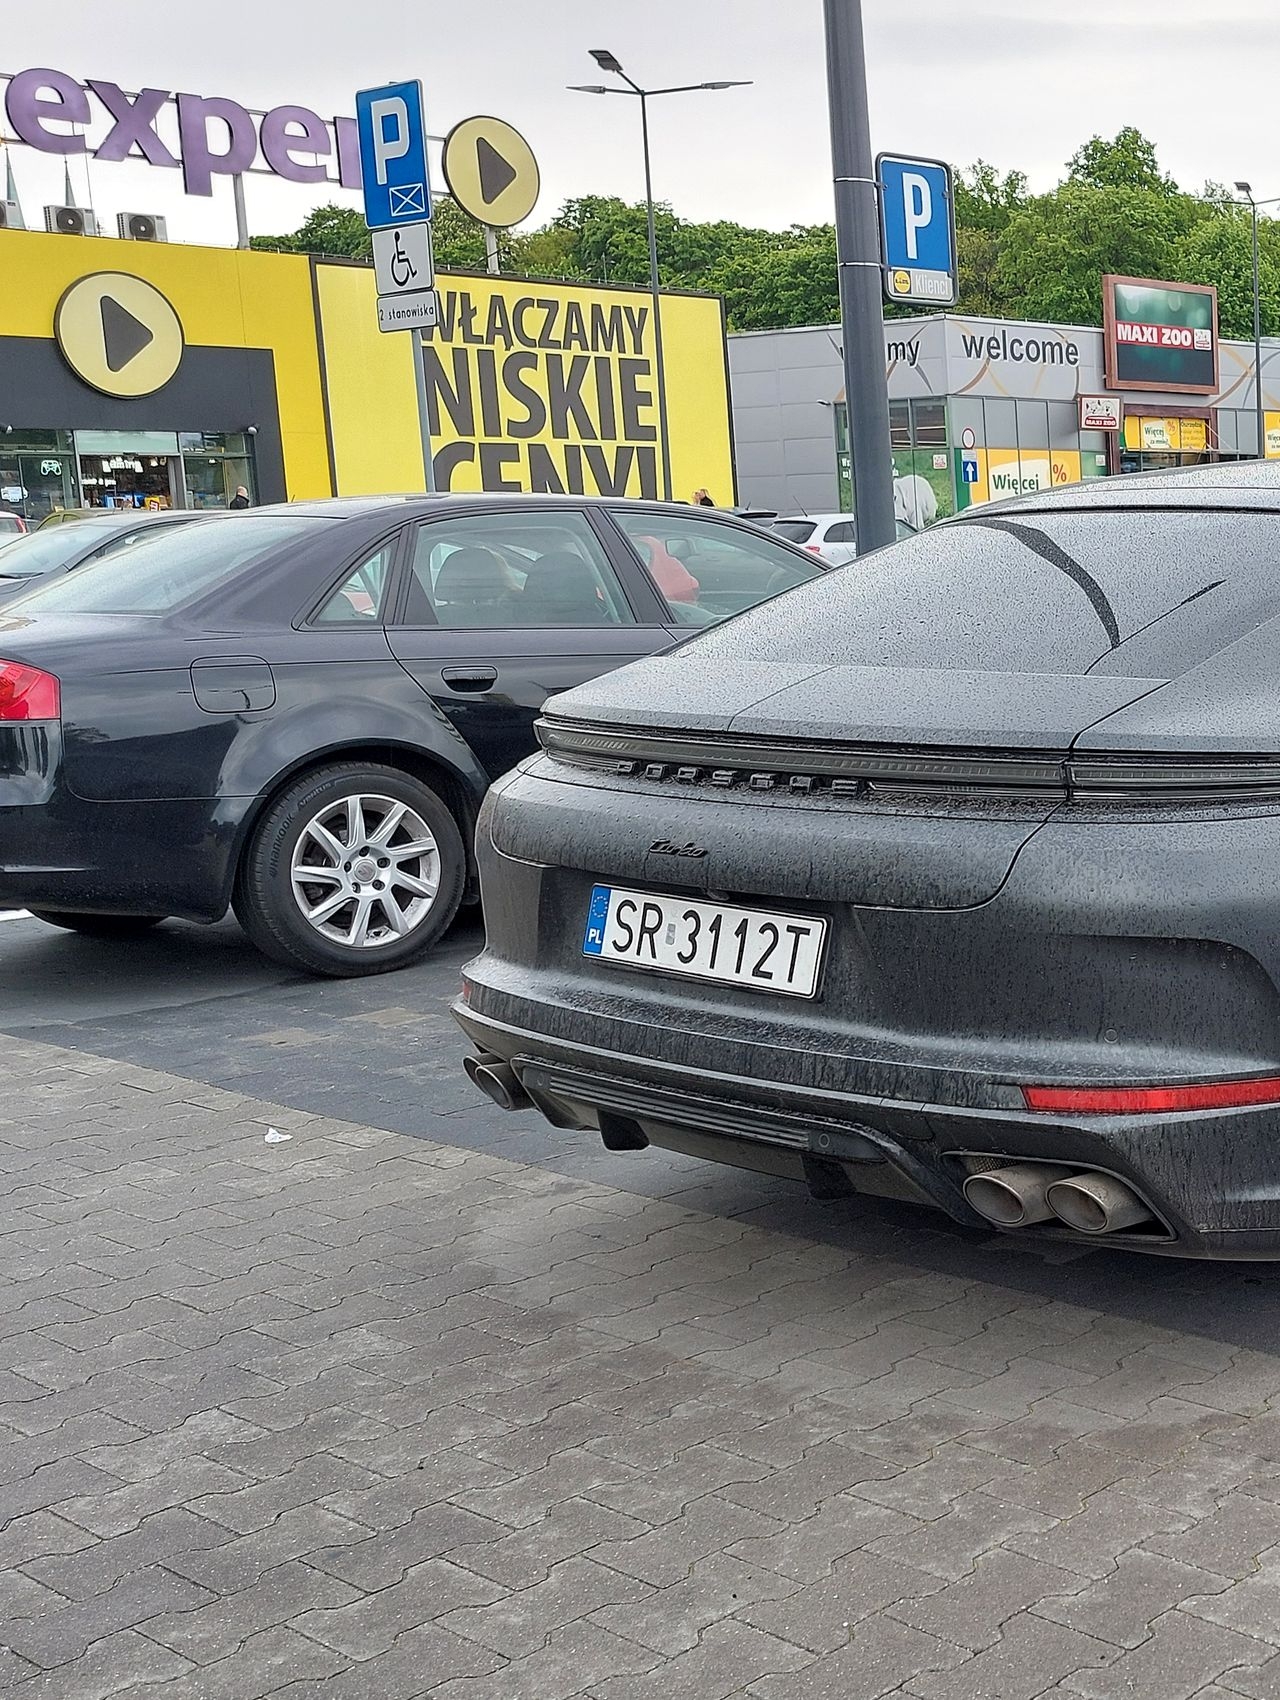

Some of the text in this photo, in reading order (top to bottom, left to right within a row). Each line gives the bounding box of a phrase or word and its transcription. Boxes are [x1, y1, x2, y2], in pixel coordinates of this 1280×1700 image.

[370, 96, 410, 186] P
[902, 172, 932, 259] P
[915, 273, 949, 296] Klienci
[380, 303, 434, 321] 2 stanowiska
[421, 291, 648, 355] WŁĄCZAMY
[961, 329, 1079, 366] welcome
[1117, 323, 1192, 347] MAXI ZOO
[422, 345, 658, 442] NISKIE
[992, 473, 1039, 495] Więcej
[617, 760, 859, 797] PORSCHE
[588, 928, 602, 945] PL
[612, 899, 812, 984] SR 3112T
